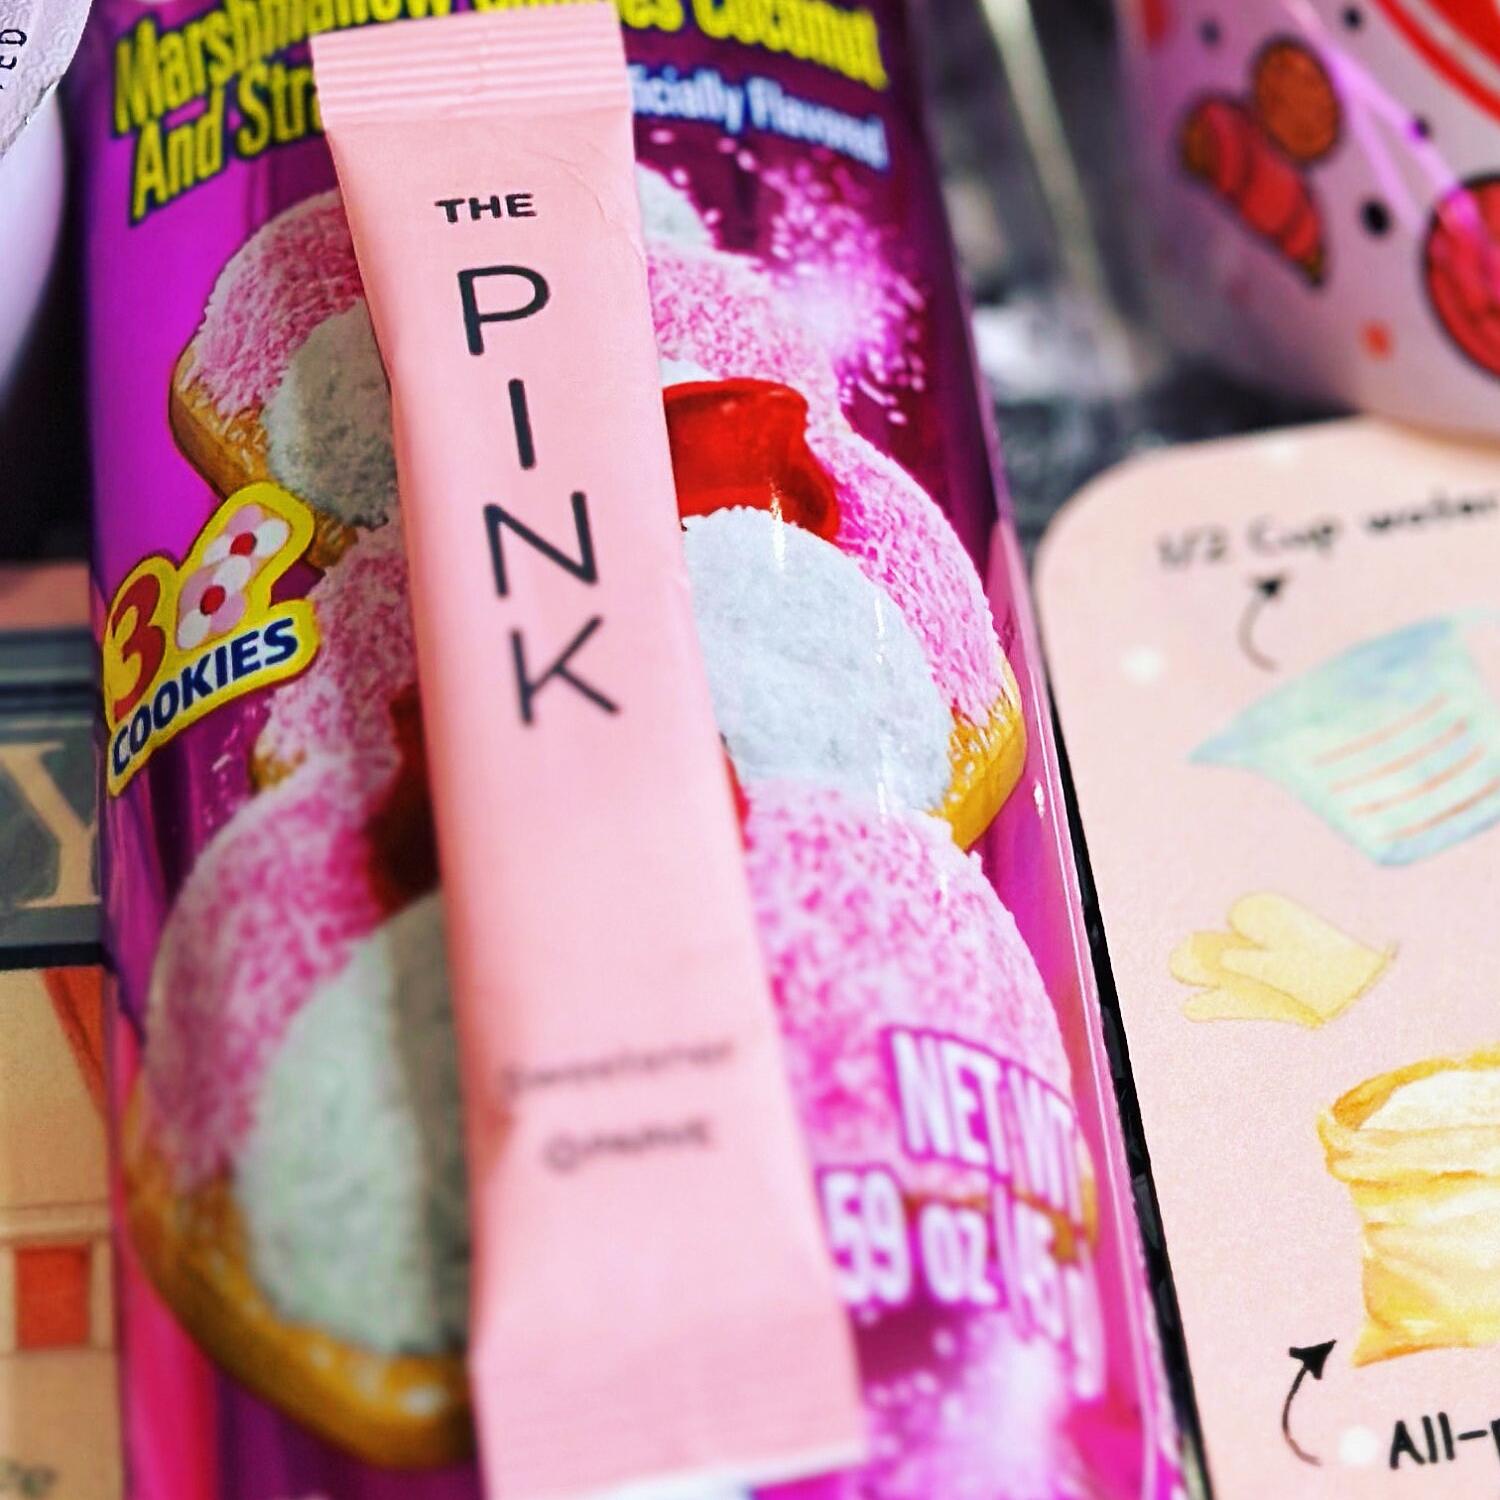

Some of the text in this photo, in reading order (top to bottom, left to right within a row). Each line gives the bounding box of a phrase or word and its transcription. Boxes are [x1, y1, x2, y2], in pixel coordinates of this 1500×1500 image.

[129, 63, 321, 225] And Str
[436, 193, 538, 223] THE
[457, 263, 621, 725] PINK
[1248, 515, 1337, 558] Cup
[1366, 488, 1500, 534] water
[111, 572, 167, 724] 3
[112, 617, 299, 777] COOKIES
[890, 1029, 1008, 1176] NET
[918, 1202, 1000, 1304] OZ
